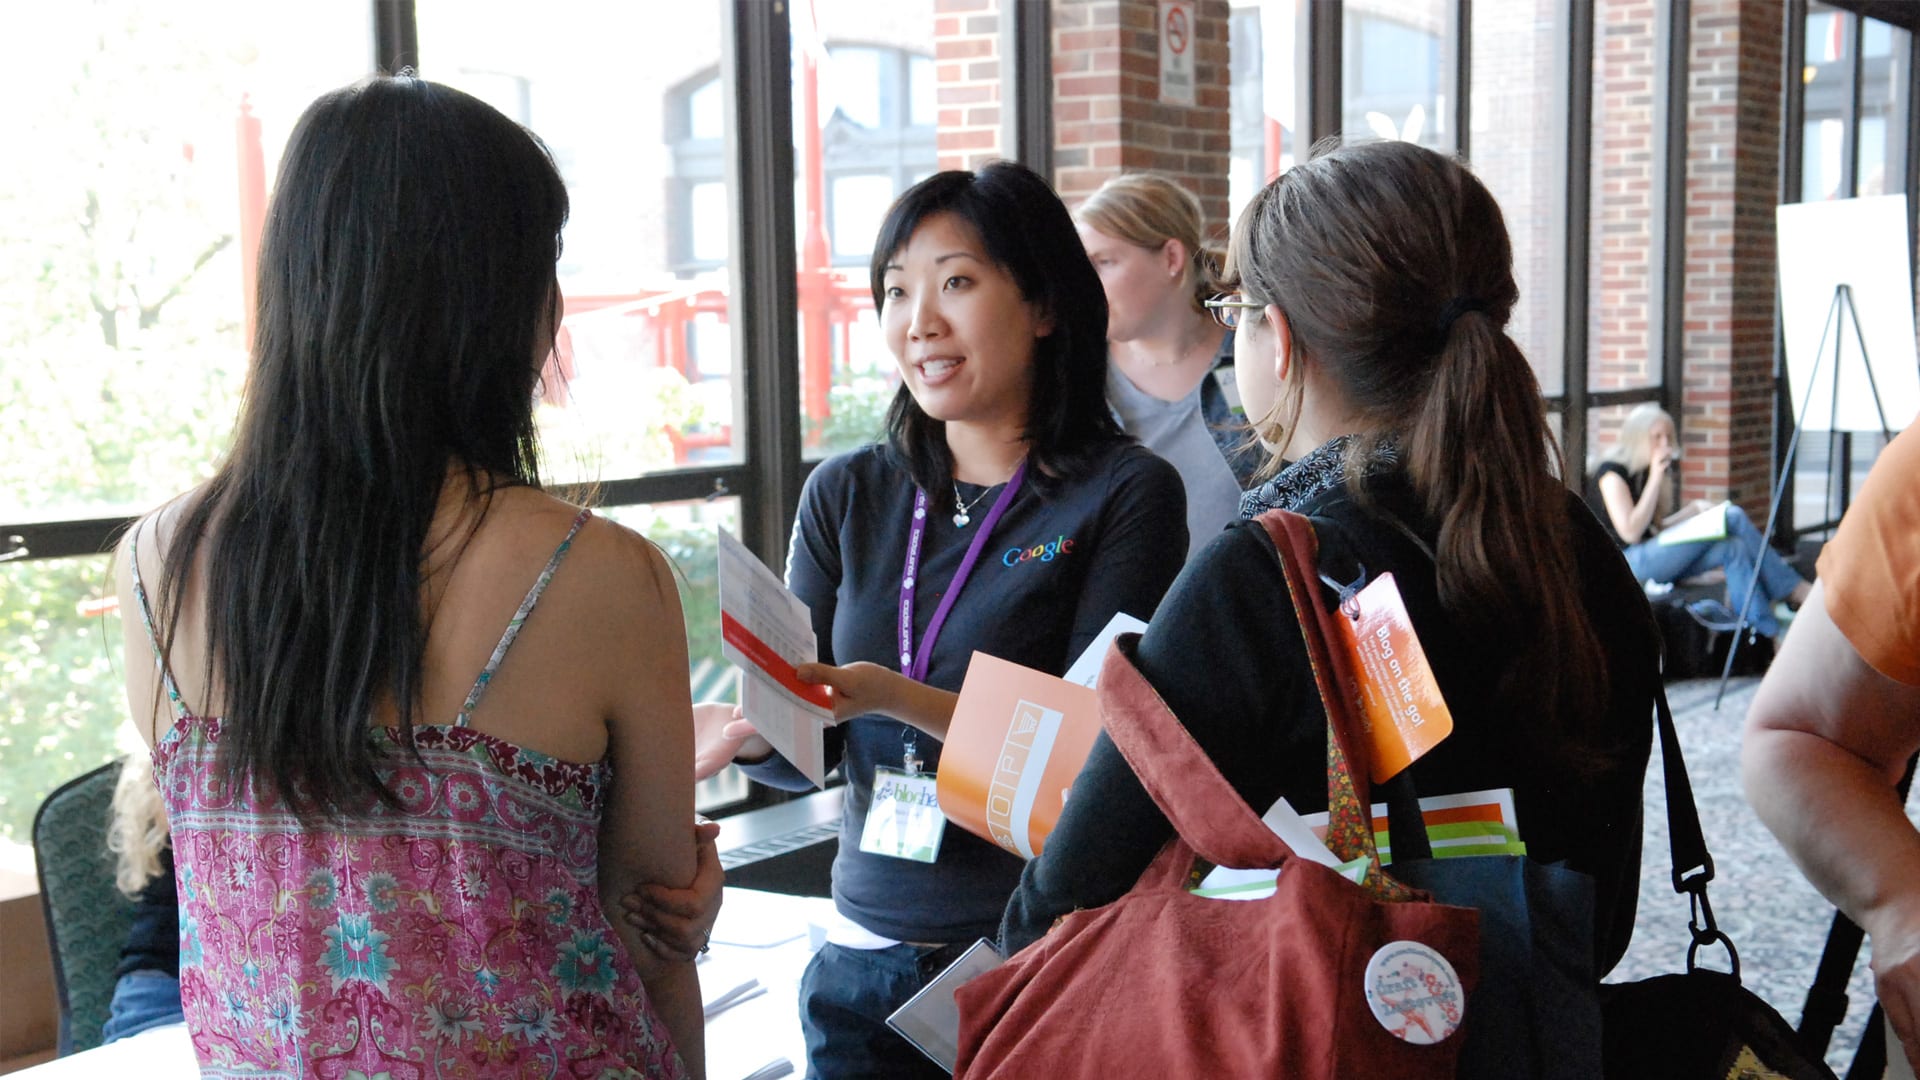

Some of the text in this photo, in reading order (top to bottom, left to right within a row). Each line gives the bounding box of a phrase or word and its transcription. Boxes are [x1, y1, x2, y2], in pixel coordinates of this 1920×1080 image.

[1002, 535, 1074, 567] Google
[1376, 624, 1394, 660] Blog
[1389, 659, 1402, 679] on
[1398, 677, 1413, 704] the
[1404, 703, 1425, 728] go!
